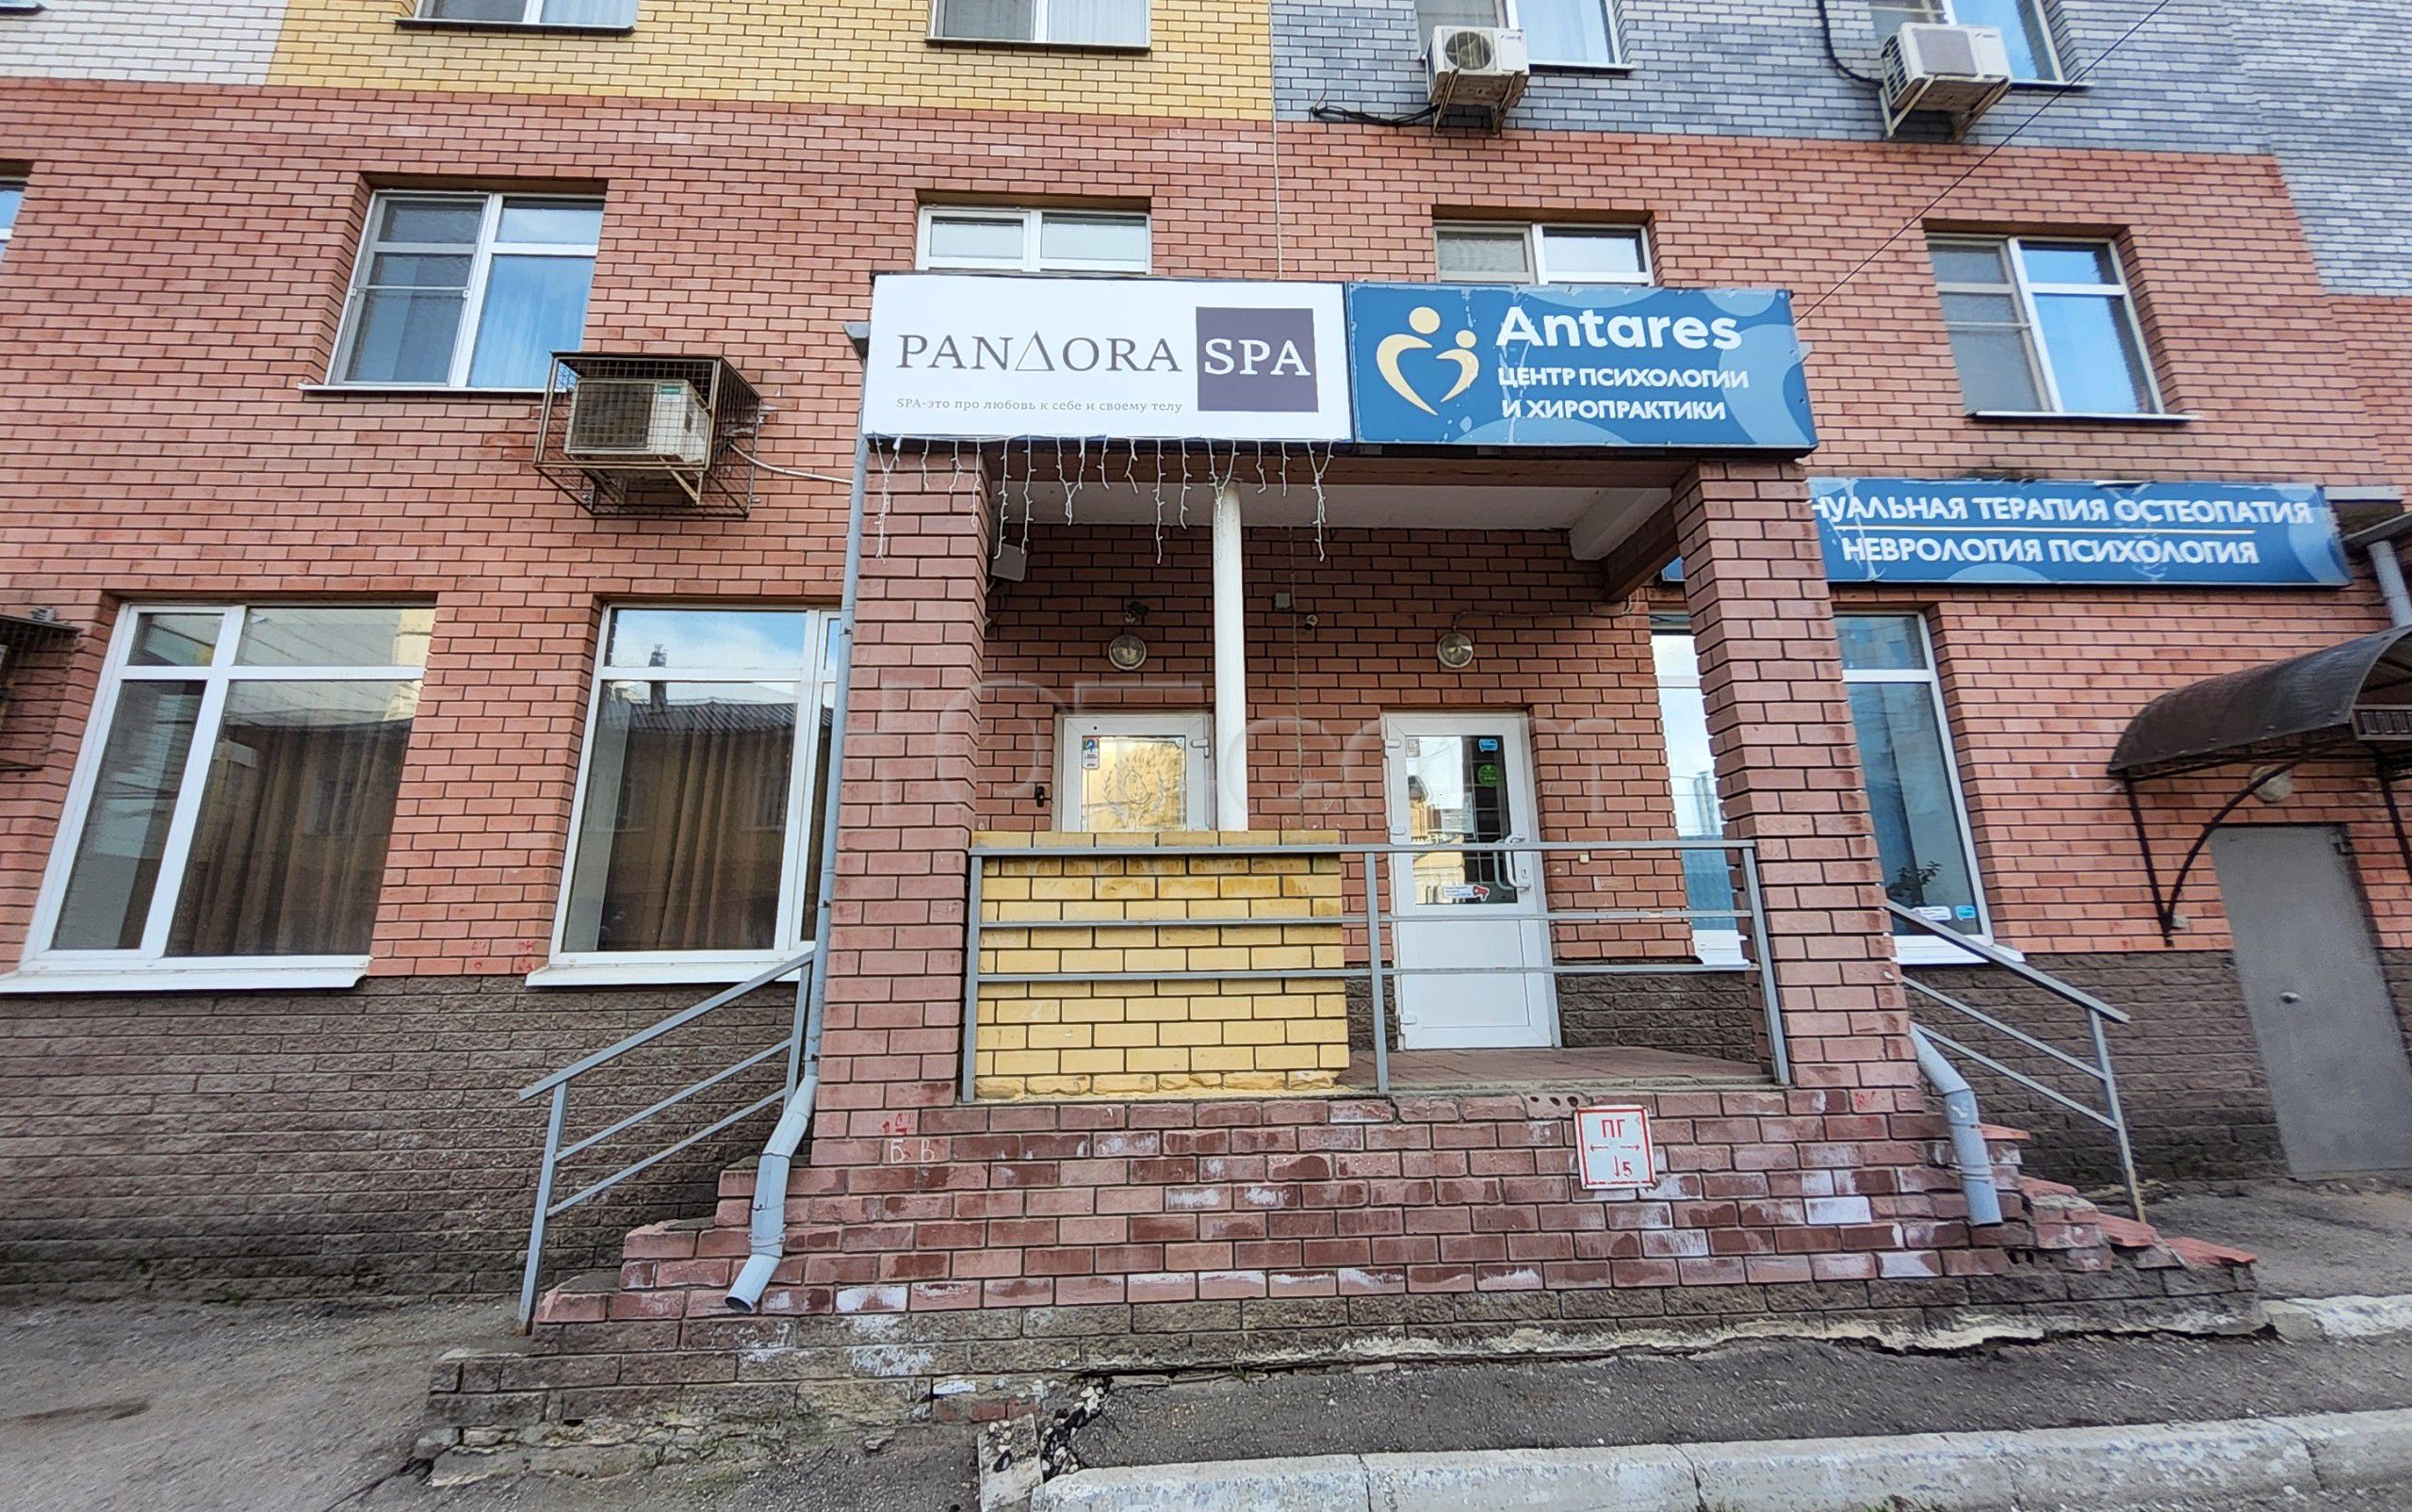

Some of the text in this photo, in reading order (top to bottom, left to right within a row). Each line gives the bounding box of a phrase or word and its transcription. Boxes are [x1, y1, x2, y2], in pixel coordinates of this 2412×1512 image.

[1496, 305, 1742, 350] Antares
[1203, 336, 1312, 377] SPA
[1497, 366, 1750, 389] ЦЕНТР ПСИХОЛОГИИ
[896, 398, 951, 409] SPA-это
[954, 399, 980, 410] про
[983, 399, 1036, 411] любовь
[1051, 399, 1083, 412] себе
[1085, 402, 1096, 412] и
[1099, 402, 1148, 414] своему
[1150, 402, 1182, 415] телу
[1502, 400, 1726, 420] И ХИРОПРАКТИКИ
[1972, 496, 2110, 523] ТЕРАПИЯ
[2118, 498, 2315, 524] ОСТЕОПАТИЯ
[1841, 537, 2260, 564] НЕВРОЛОГИЯ ПСИХОЛОГИЯ
[1602, 1119, 1625, 1138] ПГ
[1622, 1162, 1633, 1178] 5
